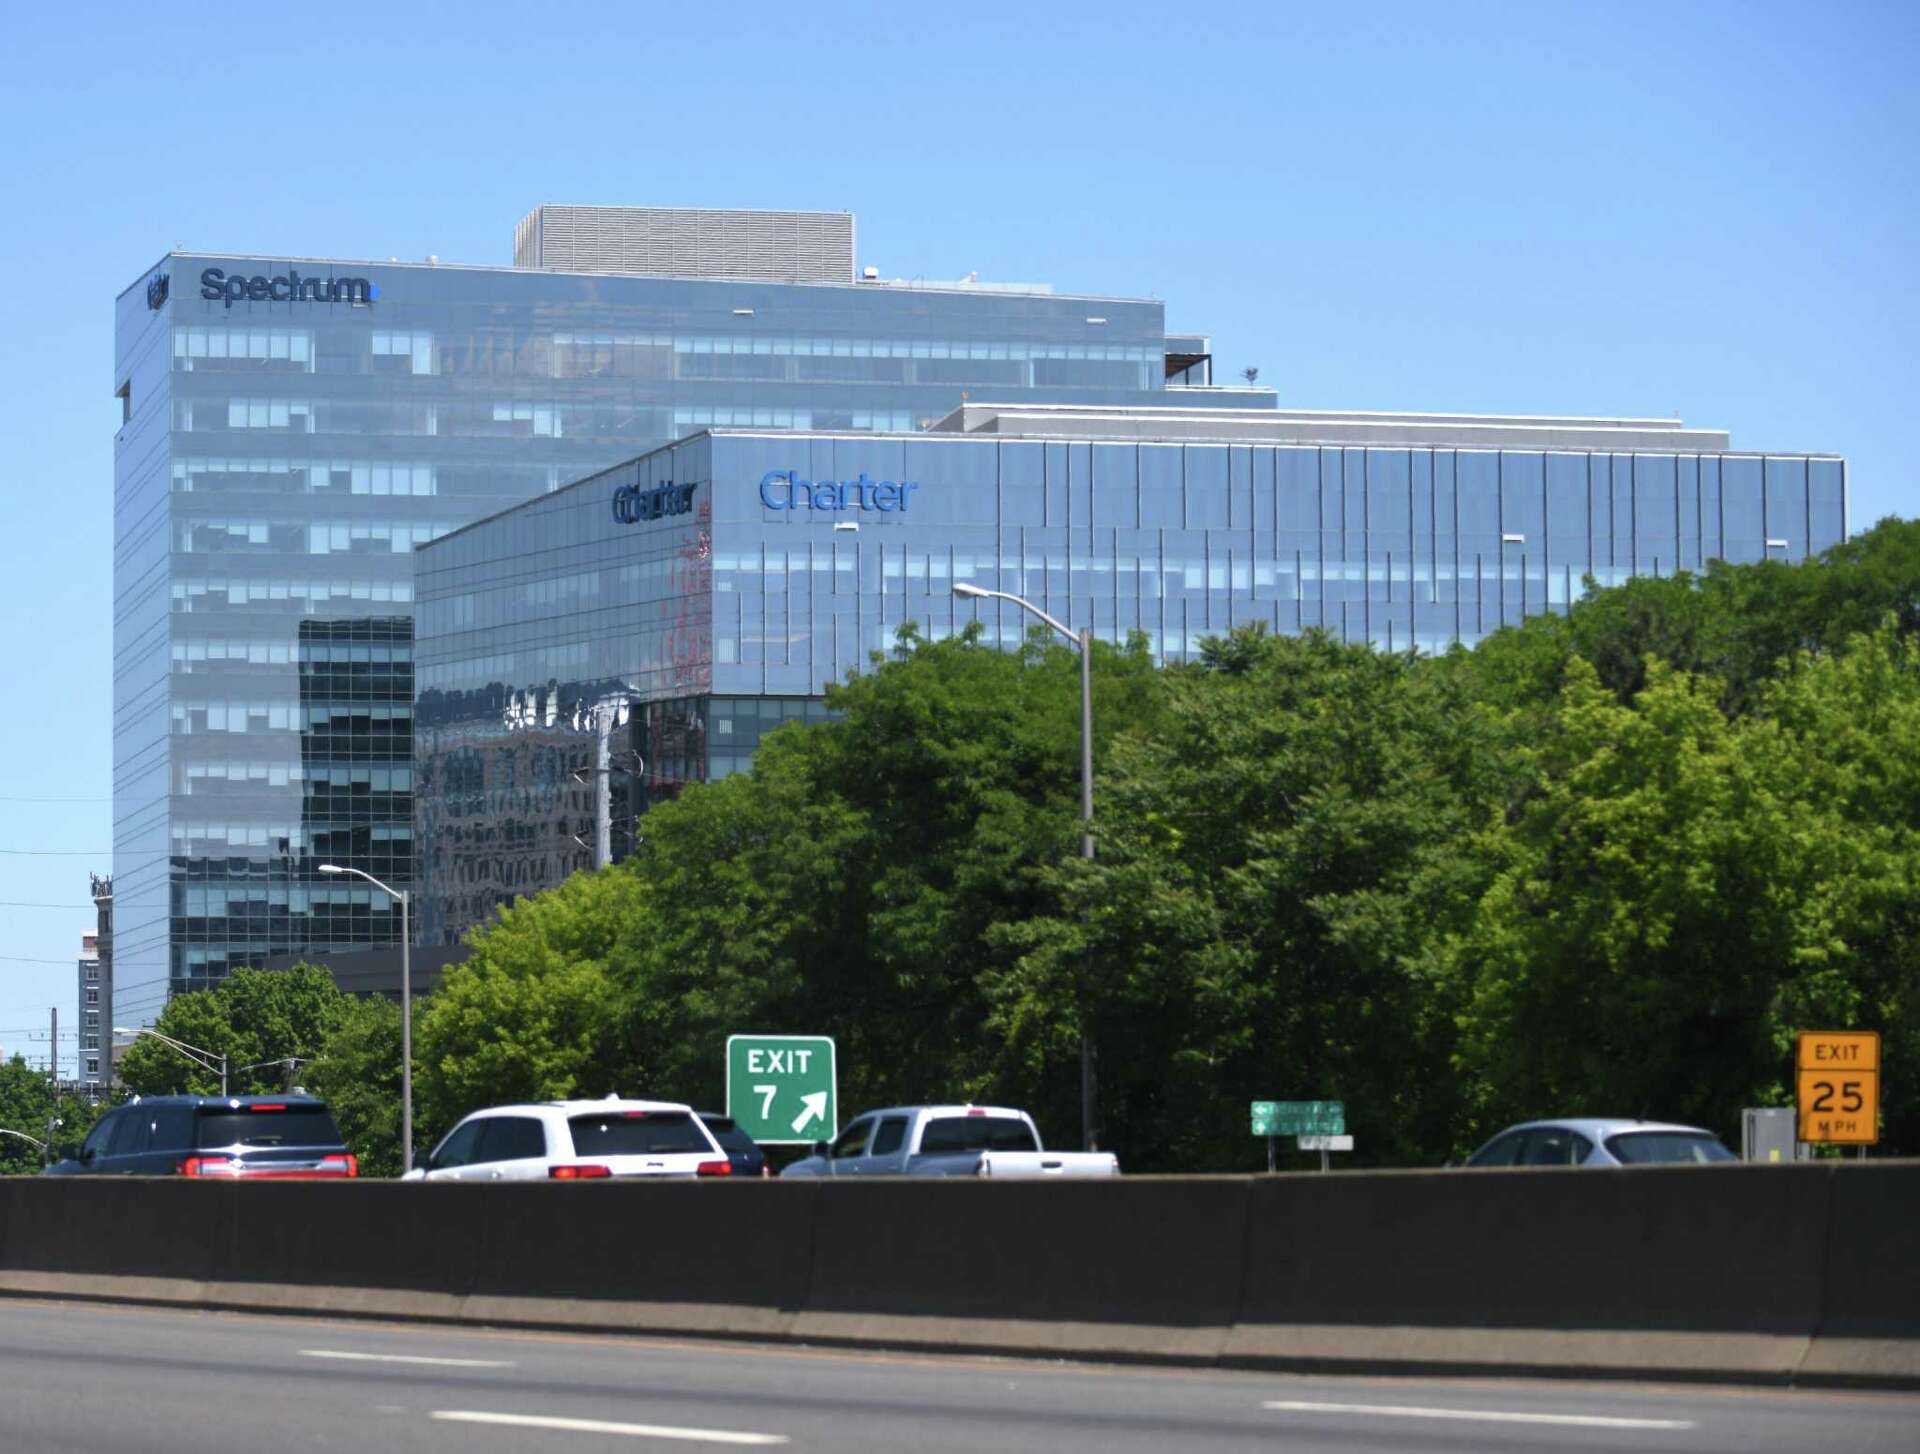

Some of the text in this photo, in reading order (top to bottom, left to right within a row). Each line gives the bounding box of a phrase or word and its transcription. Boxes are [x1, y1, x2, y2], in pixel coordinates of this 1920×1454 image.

[201, 267, 371, 308] Spectrum
[760, 470, 918, 512] Charter
[747, 1049, 813, 1074] EXIT
[1815, 1044, 1860, 1060] EXIT
[753, 1084, 777, 1120] 7
[1812, 1081, 1864, 1113] 25
[1818, 1121, 1857, 1133] MPH
